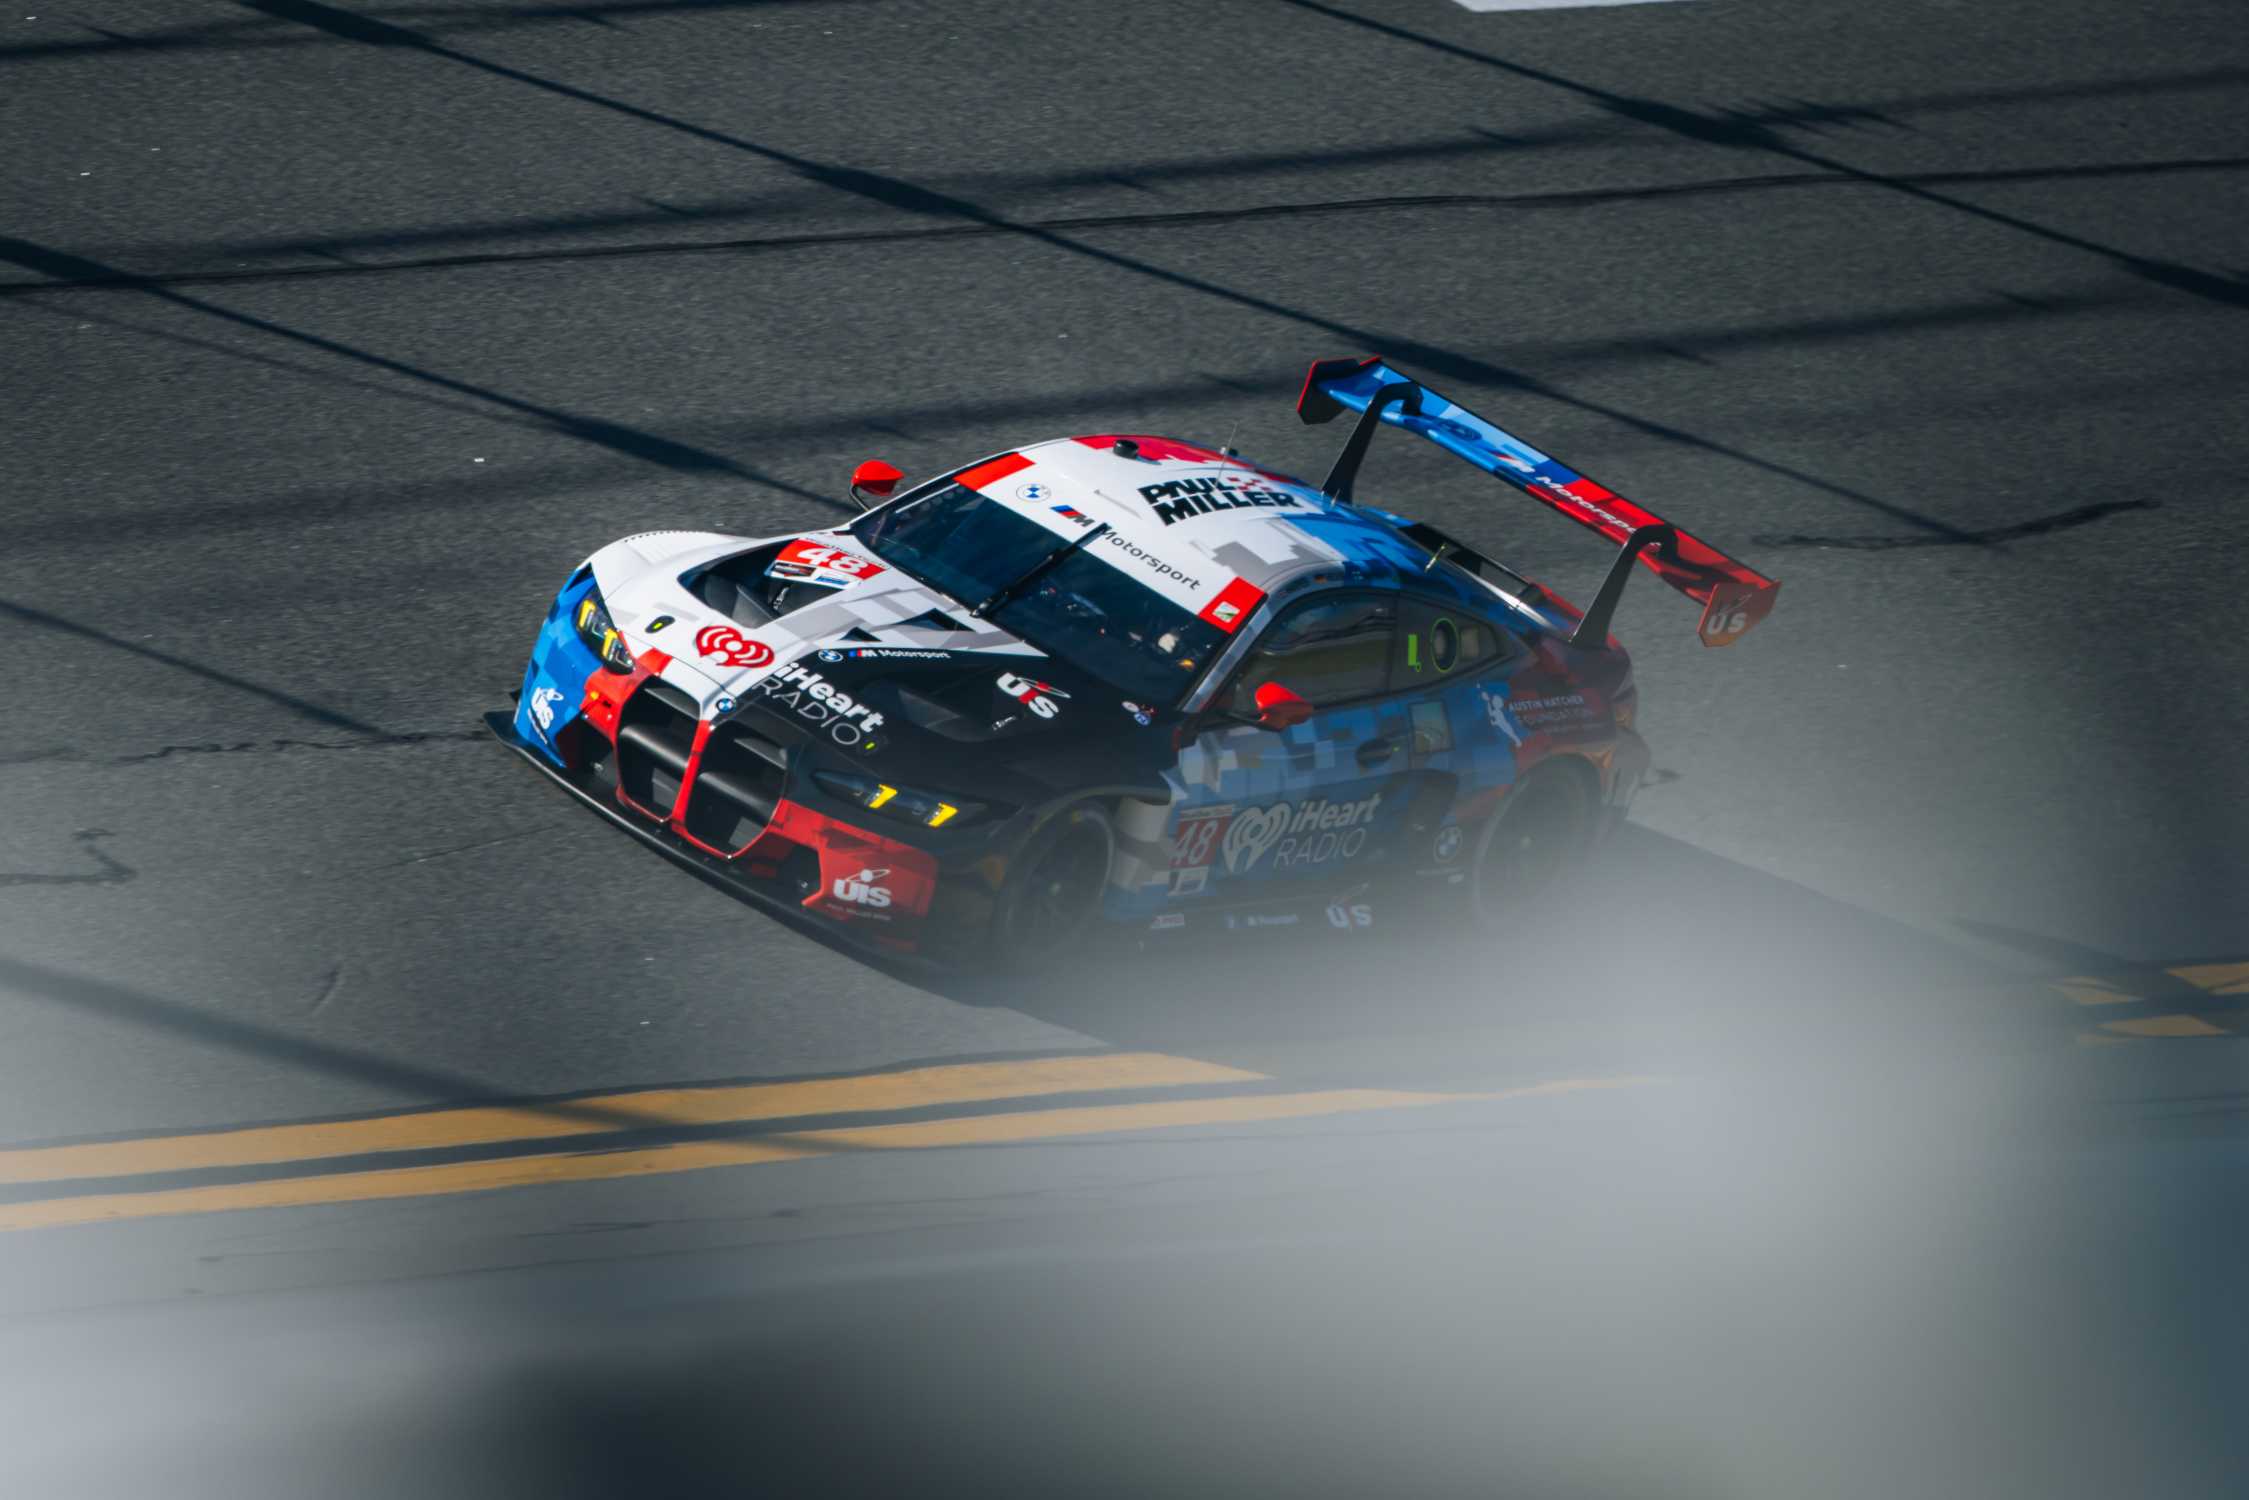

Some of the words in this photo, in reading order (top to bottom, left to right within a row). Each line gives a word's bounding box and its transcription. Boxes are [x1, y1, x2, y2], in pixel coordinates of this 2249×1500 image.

[1138, 477, 1234, 504] PAUL
[1153, 491, 1302, 527] MILLER
[1535, 475, 1638, 534] Motorspo
[796, 547, 868, 573] 48
[1101, 526, 1201, 591] Motorsport
[878, 649, 952, 661] Motorsport
[751, 677, 861, 746] RADIO
[774, 662, 886, 734] iHeart
[1508, 699, 1544, 712] AUSTIN
[1544, 695, 1585, 708] HATCHER
[1289, 792, 1382, 834] iHeart
[1168, 820, 1218, 865] 48
[1273, 827, 1368, 869] RADIO
